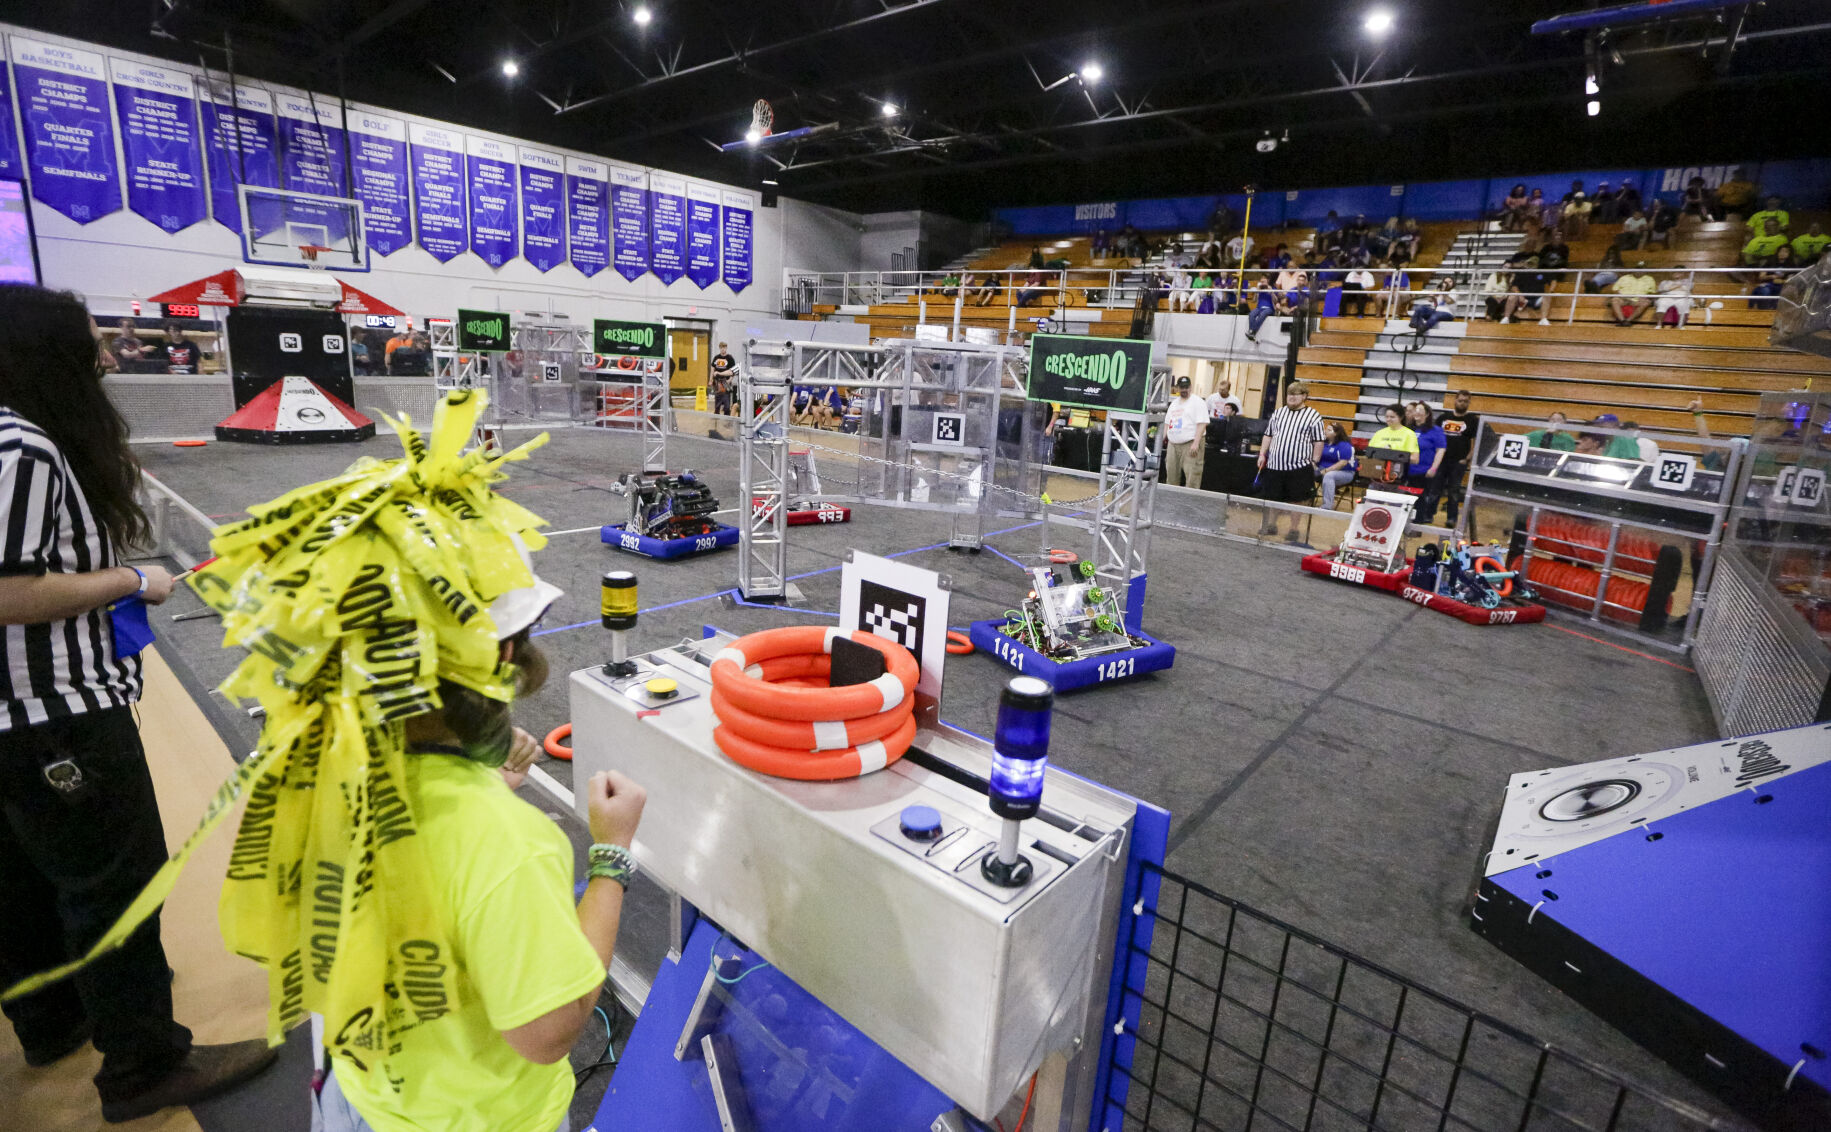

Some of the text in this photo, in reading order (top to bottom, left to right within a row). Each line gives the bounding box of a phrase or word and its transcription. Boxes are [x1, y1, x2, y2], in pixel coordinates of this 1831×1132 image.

[44, 48, 72, 59] BOYS
[21, 53, 96, 75] BASKETBALL
[38, 78, 87, 93] DISTRICT
[41, 88, 88, 103] CHAMPS
[134, 97, 178, 112] DISTRICT
[136, 106, 178, 120] CHAMPS
[44, 122, 94, 137] QUARTER
[363, 120, 390, 131] GOLF
[51, 132, 90, 145] FINALS
[362, 142, 394, 152] DISTRICT
[362, 150, 394, 160] CHAMPS
[424, 154, 452, 164] DISTRICT
[522, 153, 560, 166] SOFTBALL
[148, 160, 178, 170] STATE
[424, 161, 452, 171] CHAMPS
[479, 164, 505, 174] DISTRICT
[578, 164, 597, 174] SWIM
[43, 166, 107, 182] SEMIFINALS
[480, 171, 504, 180] CHAMPS
[364, 178, 394, 188] CHAMPS
[425, 182, 454, 193] QUARTER
[429, 190, 452, 199] FINALS
[480, 196, 506, 205] QUARTER
[371, 206, 393, 215] STATE
[1076, 202, 1116, 220] VISITORS
[466, 318, 502, 341] CRESCENDO
[604, 327, 654, 348] CRESCENDO
[1046, 350, 1127, 390] CRESCENDO
[818, 511, 844, 523] 993
[620, 534, 640, 551] 2992
[696, 536, 717, 552] 2992
[1330, 562, 1366, 584] 9988
[1403, 587, 1434, 606] 9787
[1489, 610, 1518, 624] 9787
[994, 637, 1024, 671] 1421
[1098, 657, 1135, 682] 1421
[1736, 740, 1792, 781] CRESCENDO
[1687, 764, 1700, 783] VOLUME
